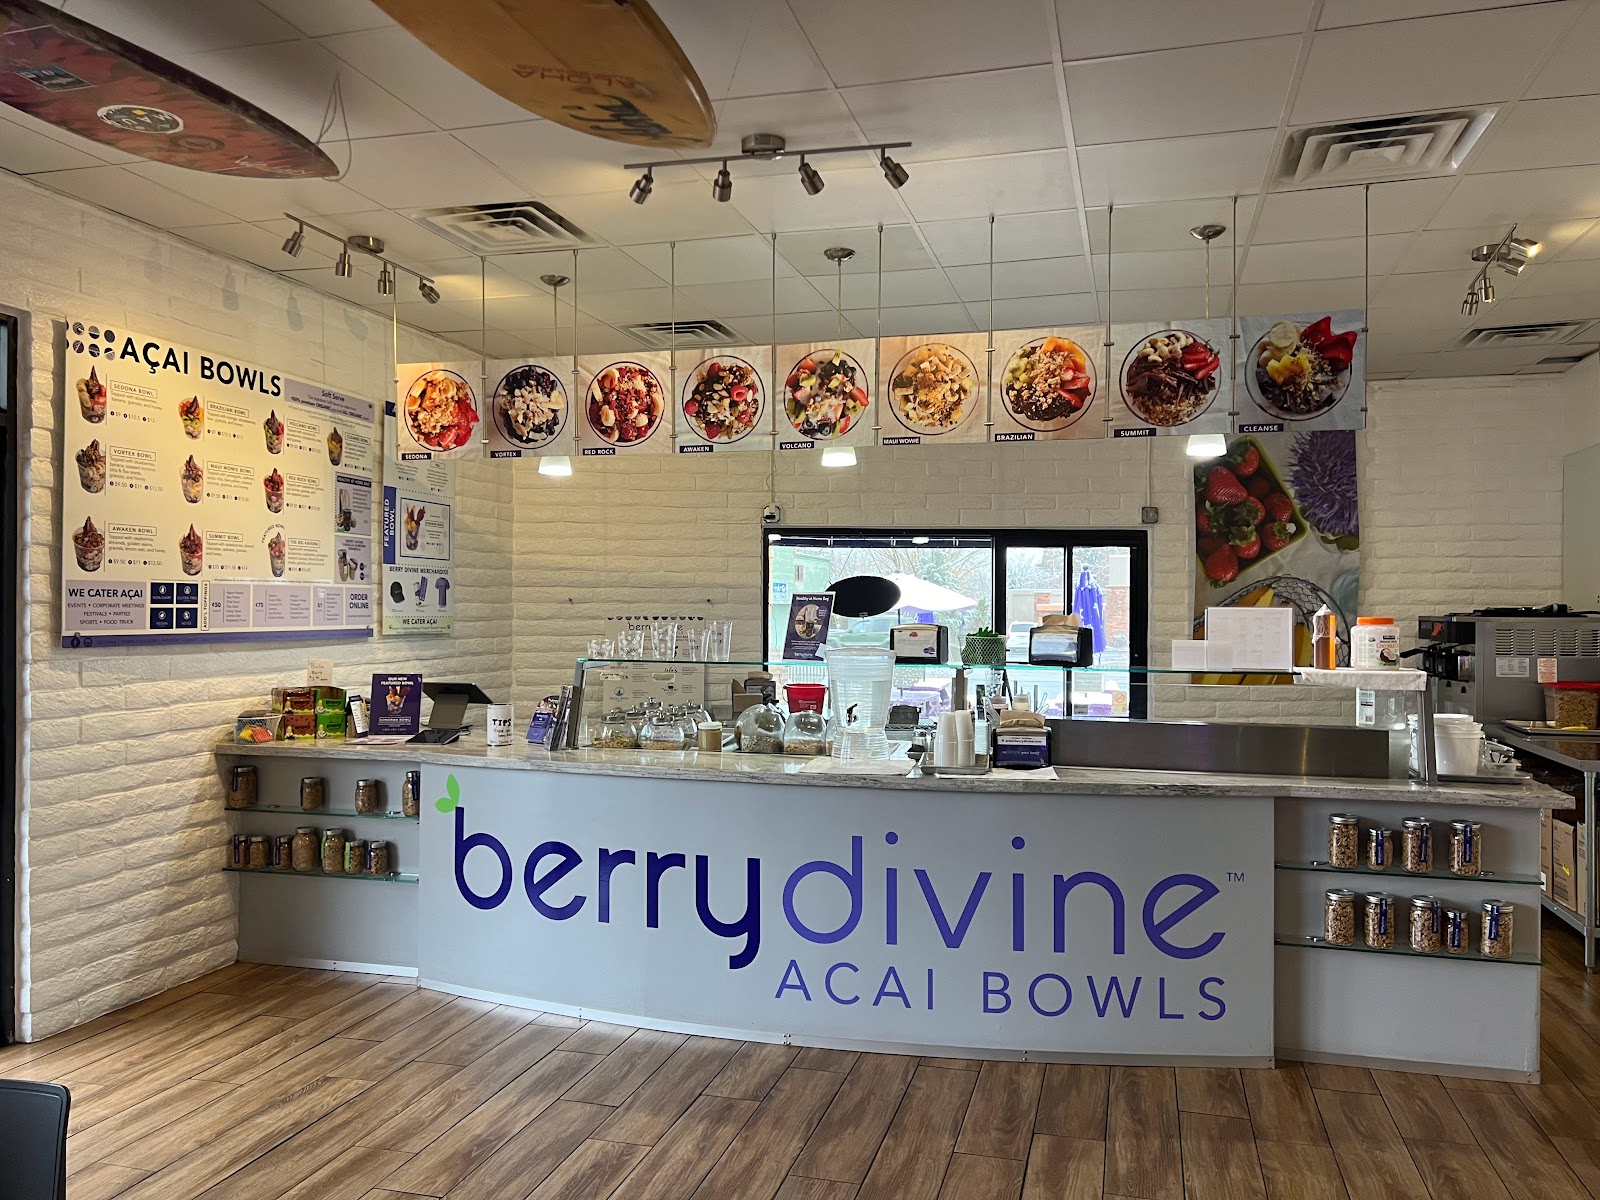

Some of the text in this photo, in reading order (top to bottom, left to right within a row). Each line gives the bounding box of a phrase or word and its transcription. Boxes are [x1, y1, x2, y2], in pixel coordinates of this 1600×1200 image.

[119, 336, 281, 397] AÇAI BOWLS
[114, 384, 154, 396] SEDONA BOWL
[322, 390, 331, 399] Soft
[210, 404, 233, 412] BRAZILIAN
[68, 589, 143, 600] WE CATER AÇAI
[350, 593, 368, 601] ORDER
[492, 718, 512, 727] TIPS
[775, 959, 1226, 1021] ACAI BOWLS
